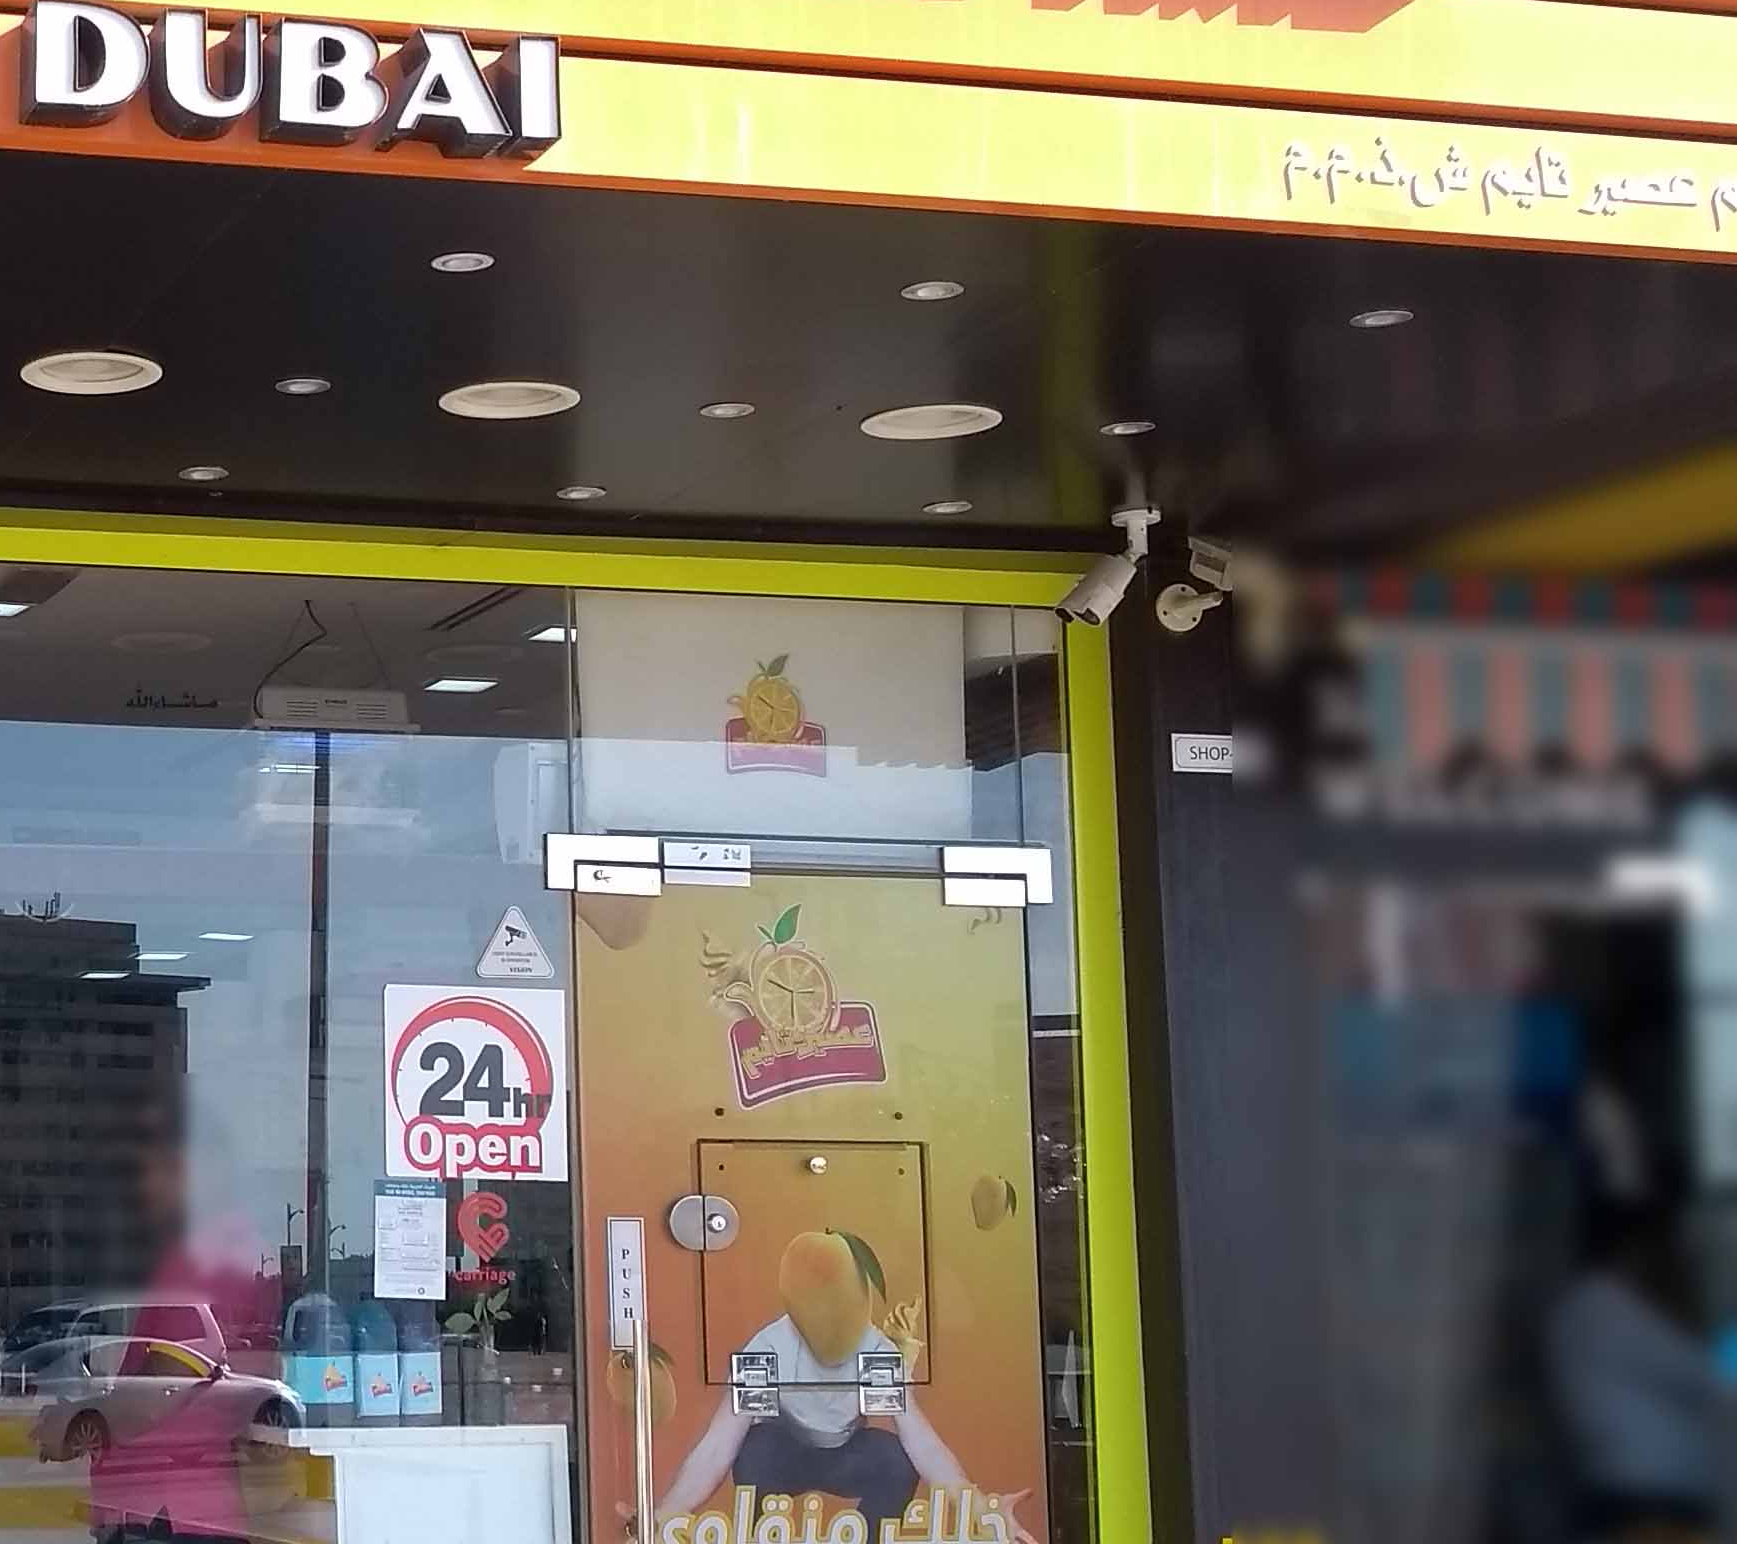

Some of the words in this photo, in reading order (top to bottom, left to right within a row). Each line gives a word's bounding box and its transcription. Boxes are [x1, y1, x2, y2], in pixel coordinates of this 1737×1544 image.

[408, 1121, 542, 1179] Open
[453, 1265, 517, 1285] carriage
[621, 1247, 634, 1319] PUSH
